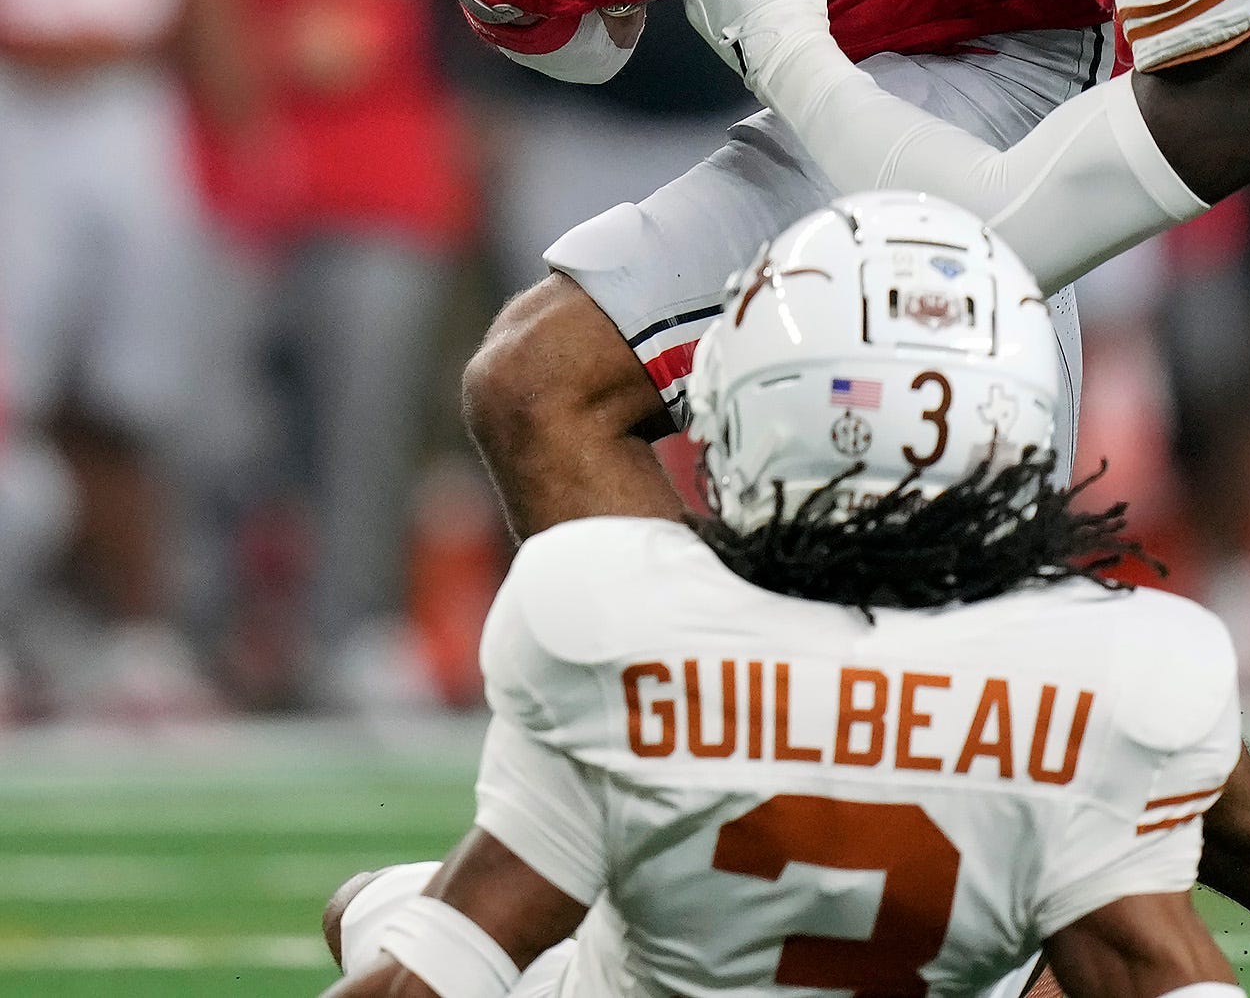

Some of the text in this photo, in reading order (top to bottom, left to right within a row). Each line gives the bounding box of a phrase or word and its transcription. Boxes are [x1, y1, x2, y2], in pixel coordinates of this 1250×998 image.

[902, 370, 953, 468] 3
[622, 659, 1094, 786] GUILBEAU
[711, 793, 961, 998] 3
